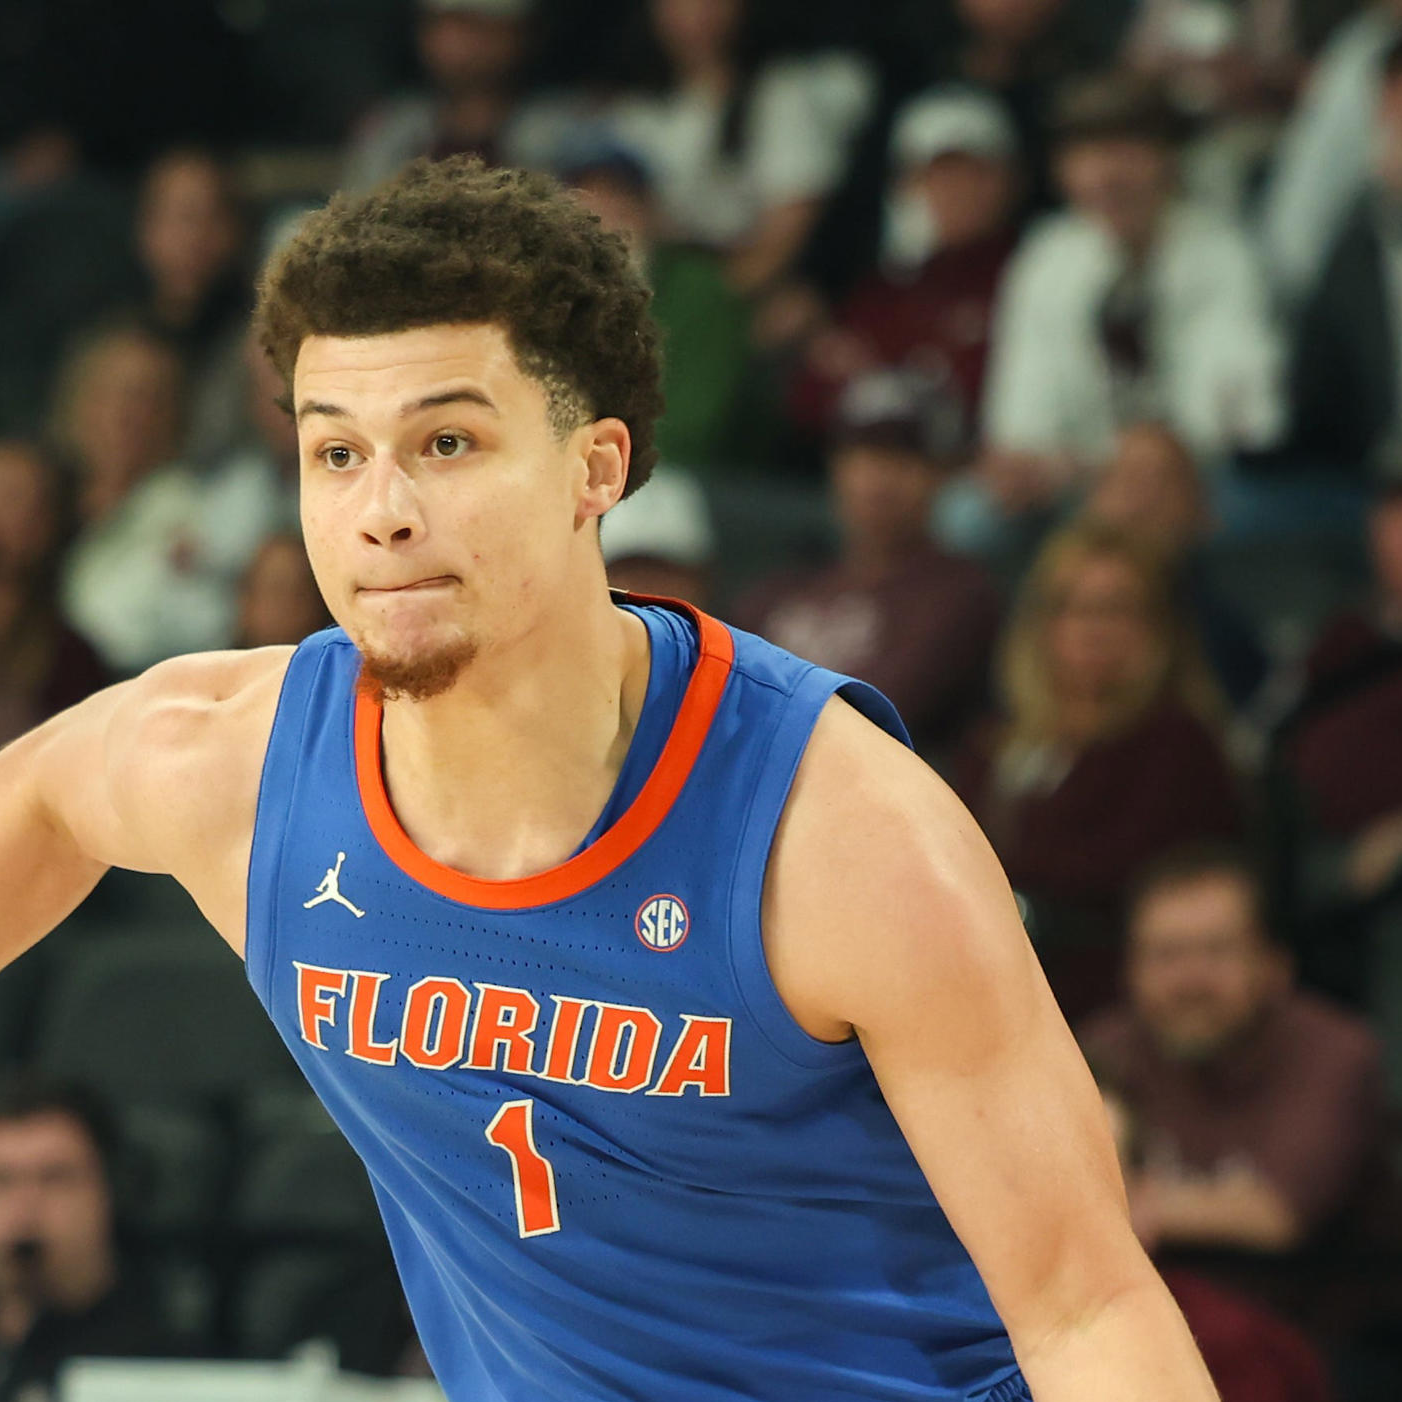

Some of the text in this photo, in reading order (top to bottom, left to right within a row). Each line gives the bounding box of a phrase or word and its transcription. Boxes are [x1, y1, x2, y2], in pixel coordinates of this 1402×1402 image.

[640, 899, 685, 948] SEC
[292, 961, 733, 1098] FLORIDA
[485, 1099, 561, 1239] 1
